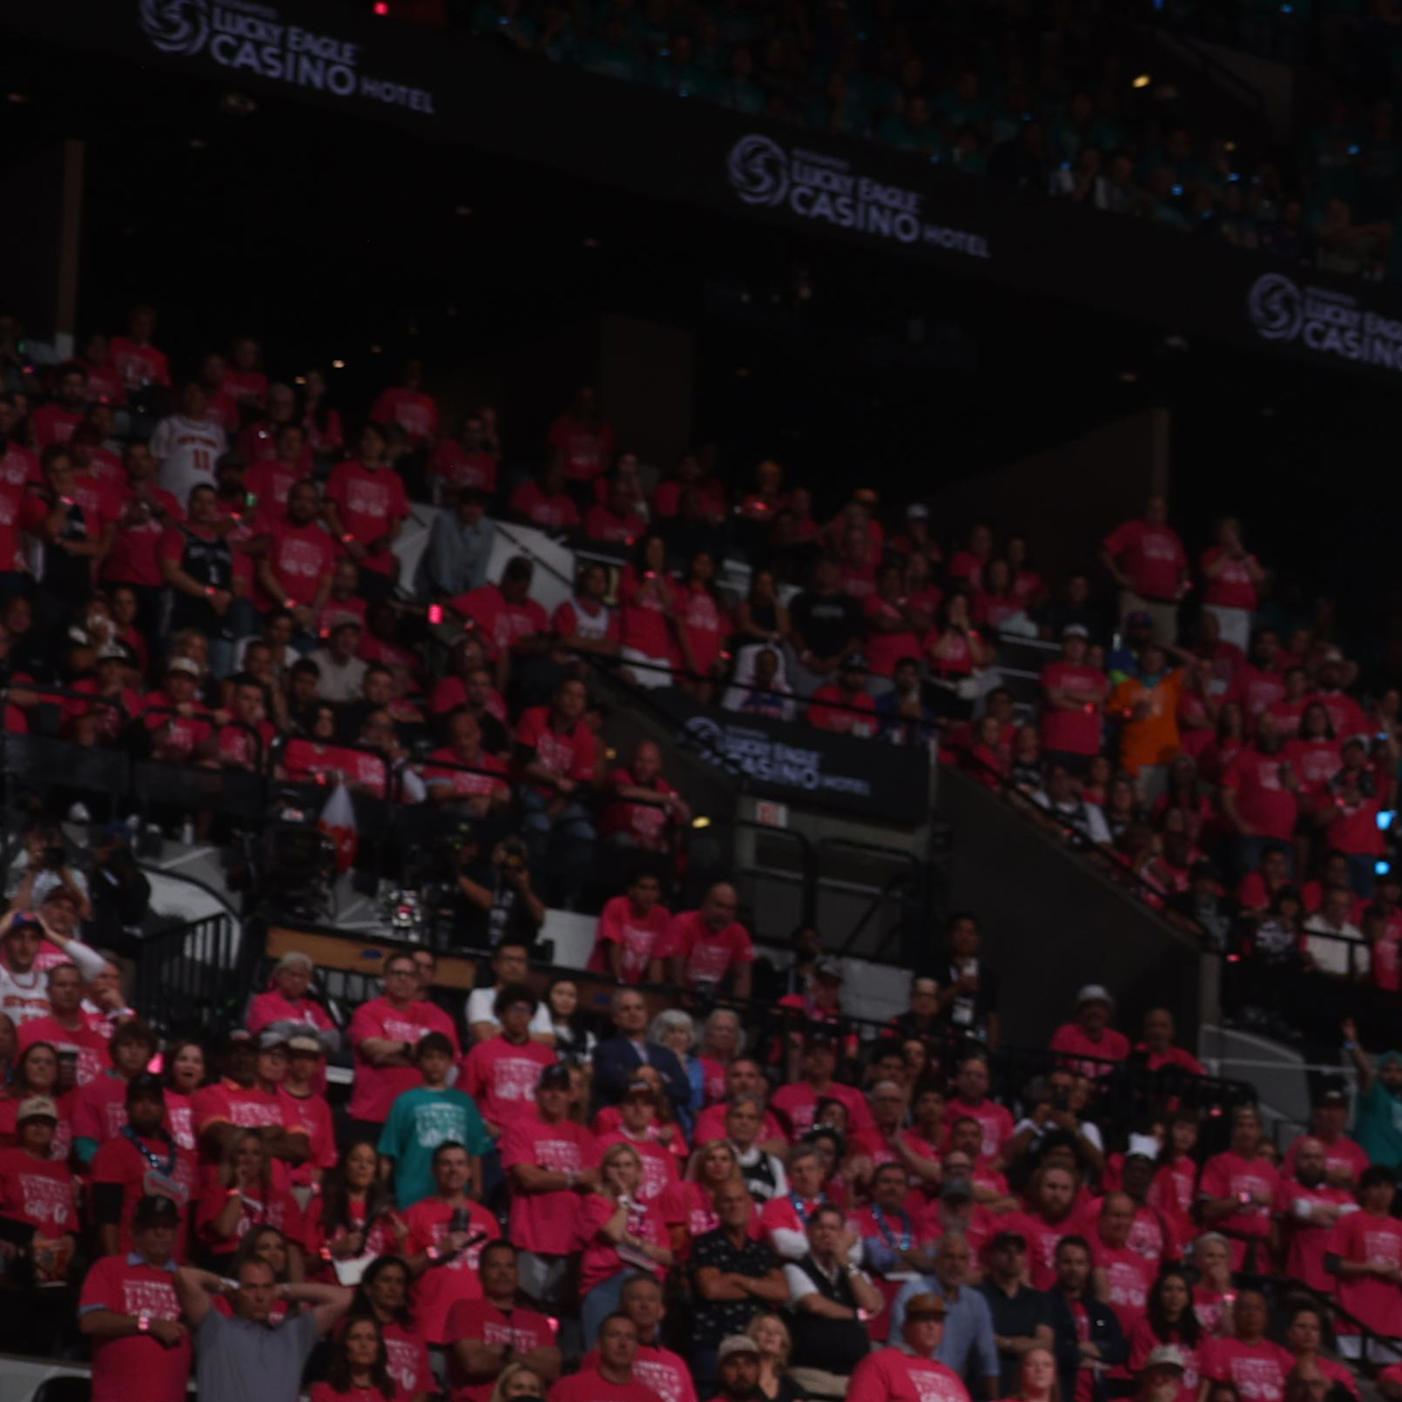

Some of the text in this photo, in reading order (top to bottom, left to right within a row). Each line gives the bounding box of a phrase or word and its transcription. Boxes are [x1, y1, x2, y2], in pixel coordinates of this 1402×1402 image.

[212, 7, 284, 45] LUCKY
[287, 25, 360, 66] EAGLE
[211, 33, 436, 114] CASINO HOTEL
[789, 186, 919, 243] CASINO
